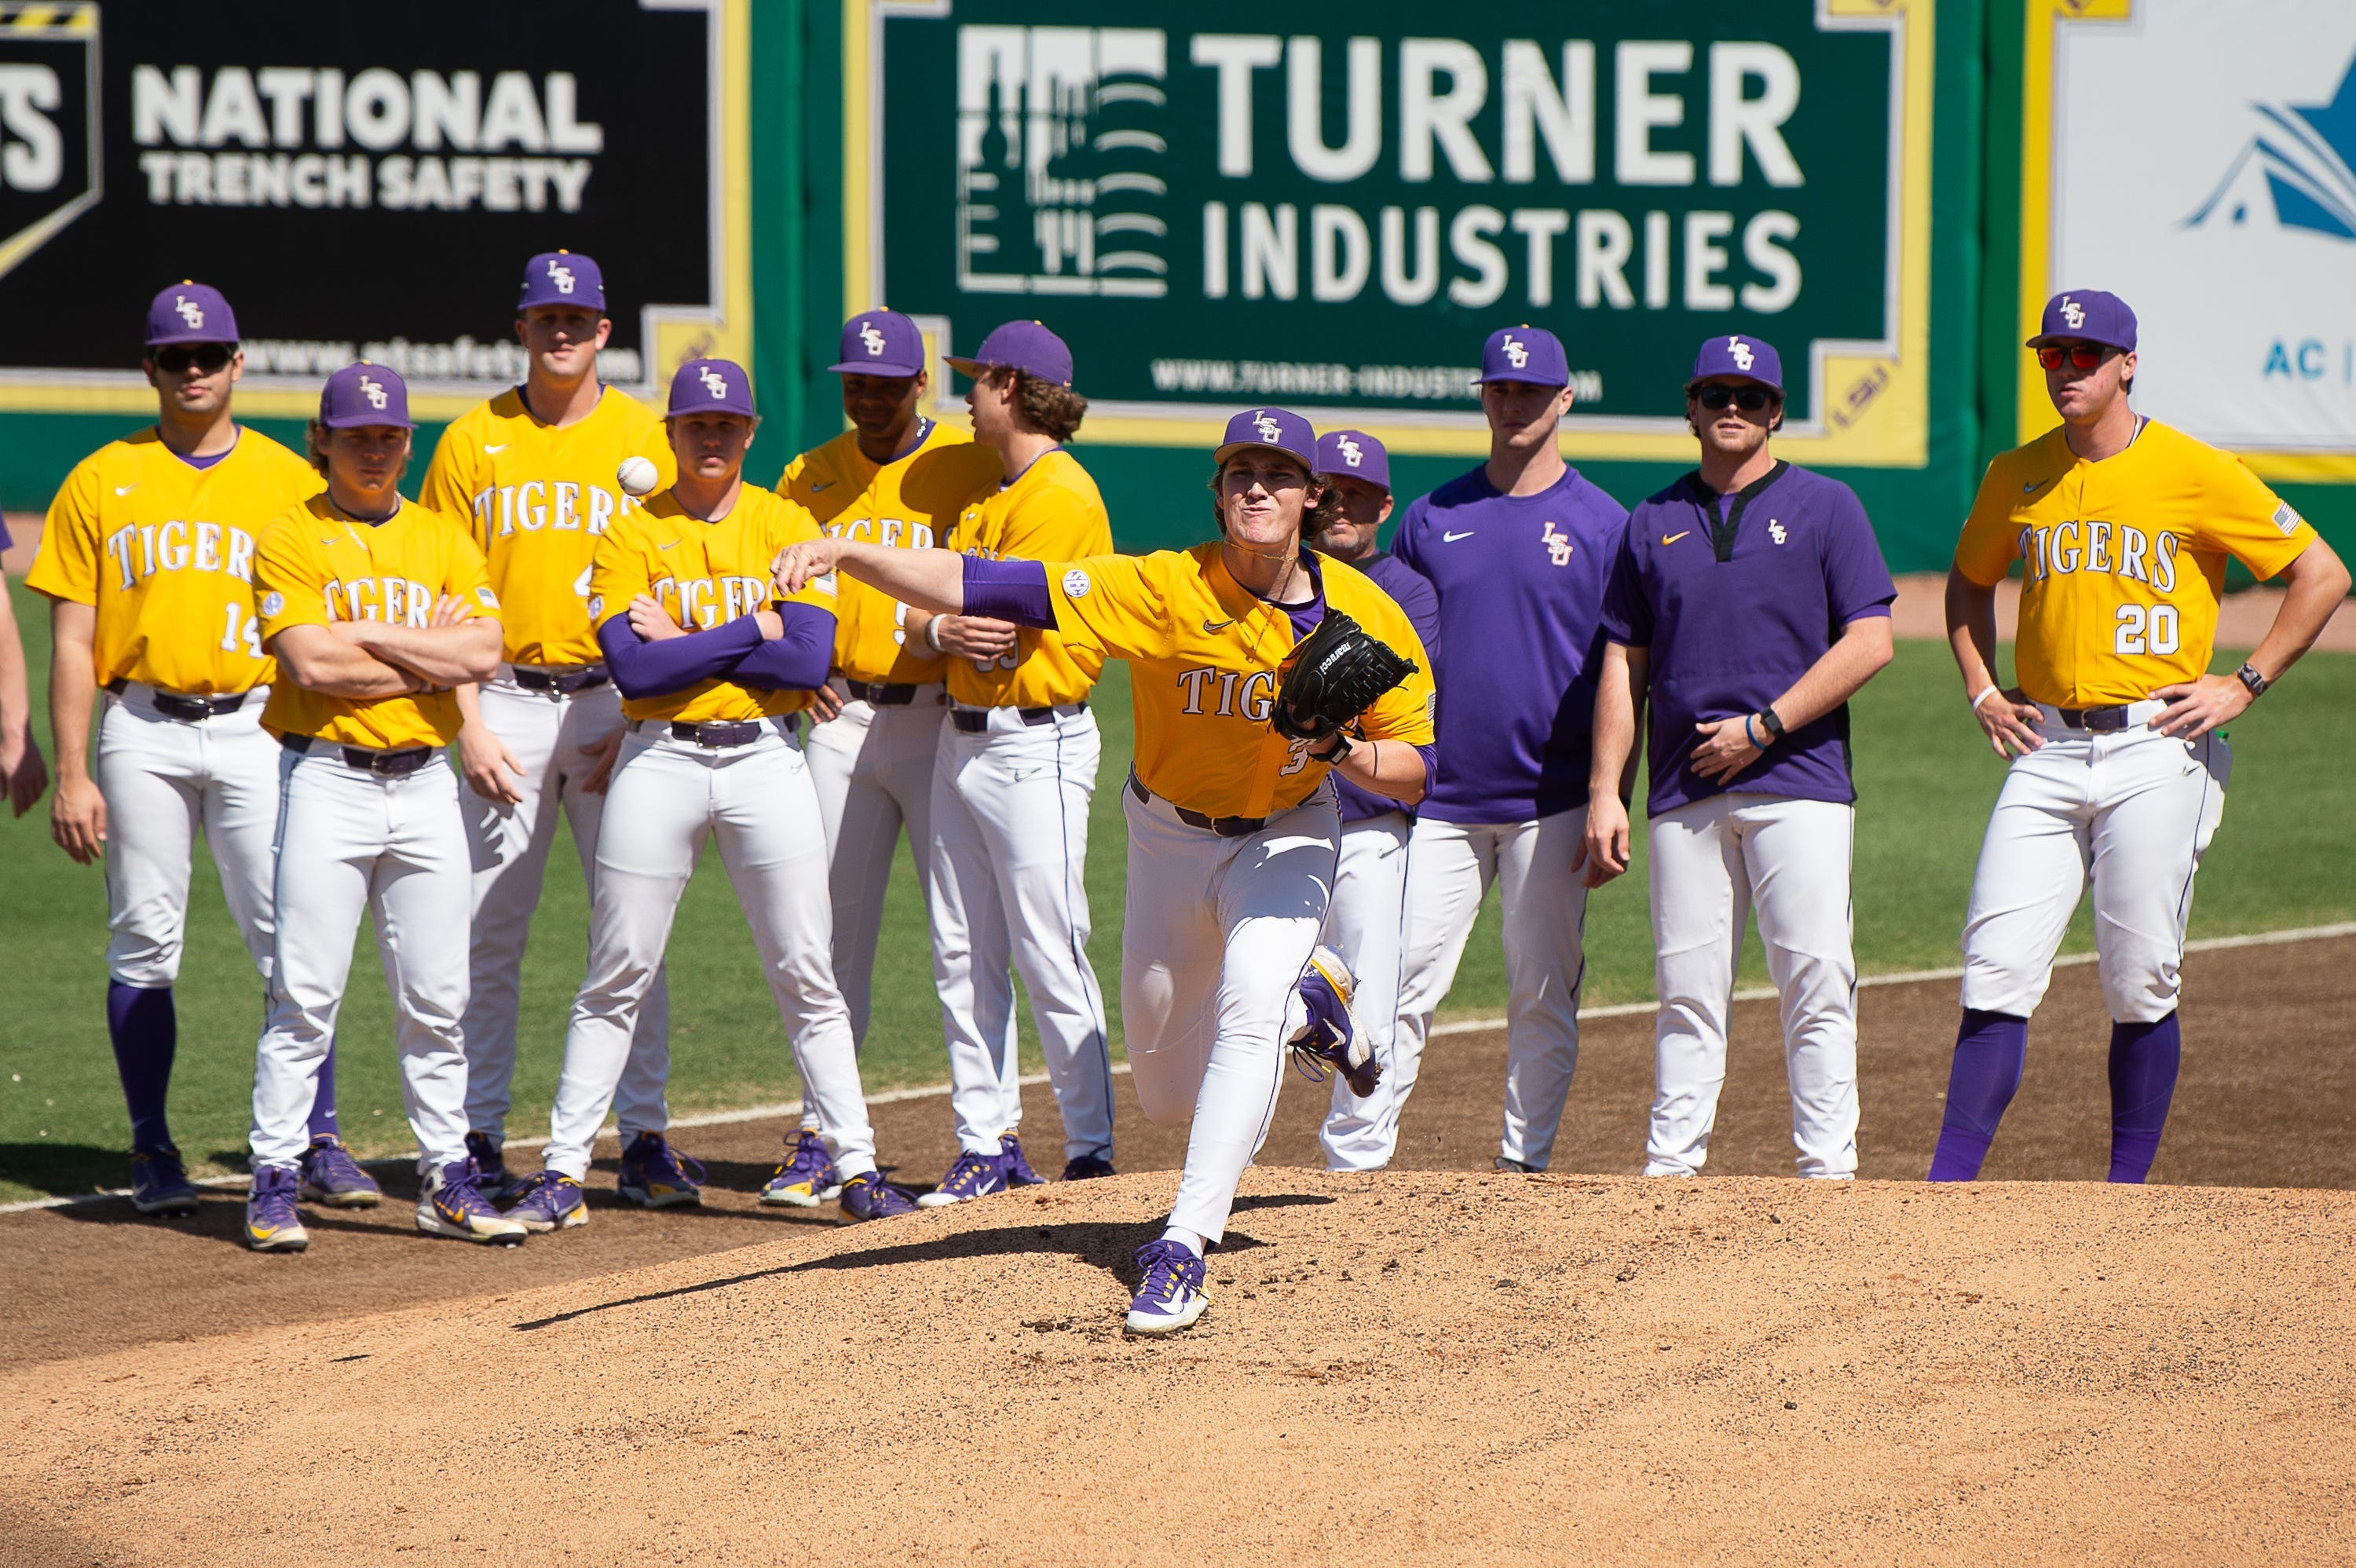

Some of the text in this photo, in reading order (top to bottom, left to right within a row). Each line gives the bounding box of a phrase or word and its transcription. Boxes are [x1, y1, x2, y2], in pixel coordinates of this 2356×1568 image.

[133, 64, 603, 153] NATIONAL
[1191, 34, 1805, 188] TURNER
[140, 152, 591, 213] TRENCH SAFETY
[1203, 201, 1802, 313] INDUSTRIES
[549, 260, 576, 294] LSU
[175, 295, 203, 329] LSU
[2059, 296, 2086, 330] LSU
[859, 321, 886, 356] LSU
[1502, 334, 1529, 369] LSU
[1727, 335, 1754, 371] LSU
[2263, 338, 2325, 380] AC
[360, 375, 388, 410] LSU
[699, 366, 728, 399] LSU
[1253, 411, 1282, 444] LSU
[1337, 434, 1364, 467] LSU
[1542, 521, 1572, 566] LSU
[1768, 519, 1787, 545] LSU
[107, 519, 254, 591] TIGER
[2018, 520, 2179, 593] TIGERS
[323, 577, 444, 629] TIGER
[653, 576, 775, 629] TIGER
[221, 602, 264, 658] 14
[2115, 604, 2179, 655] 20
[1319, 641, 1351, 675] marucci
